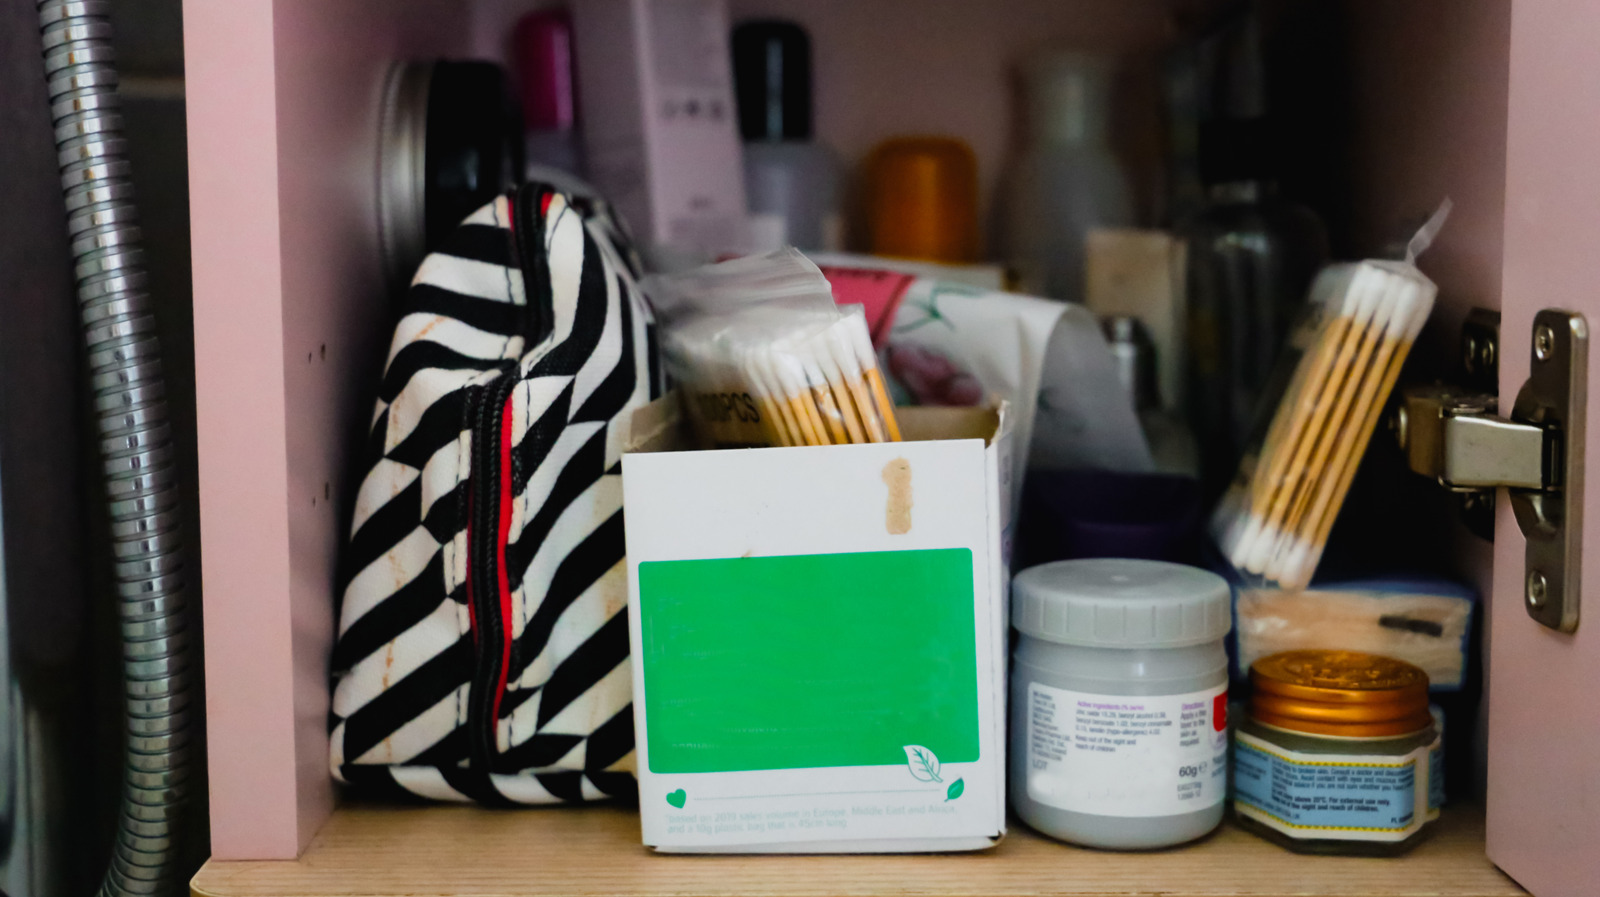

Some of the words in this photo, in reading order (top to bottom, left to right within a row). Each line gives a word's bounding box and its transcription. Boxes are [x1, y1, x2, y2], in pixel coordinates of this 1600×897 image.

[1179, 765, 1198, 778] 60g
[851, 805, 883, 816] Middle
[907, 805, 926, 815] and
[668, 824, 686, 834] and
